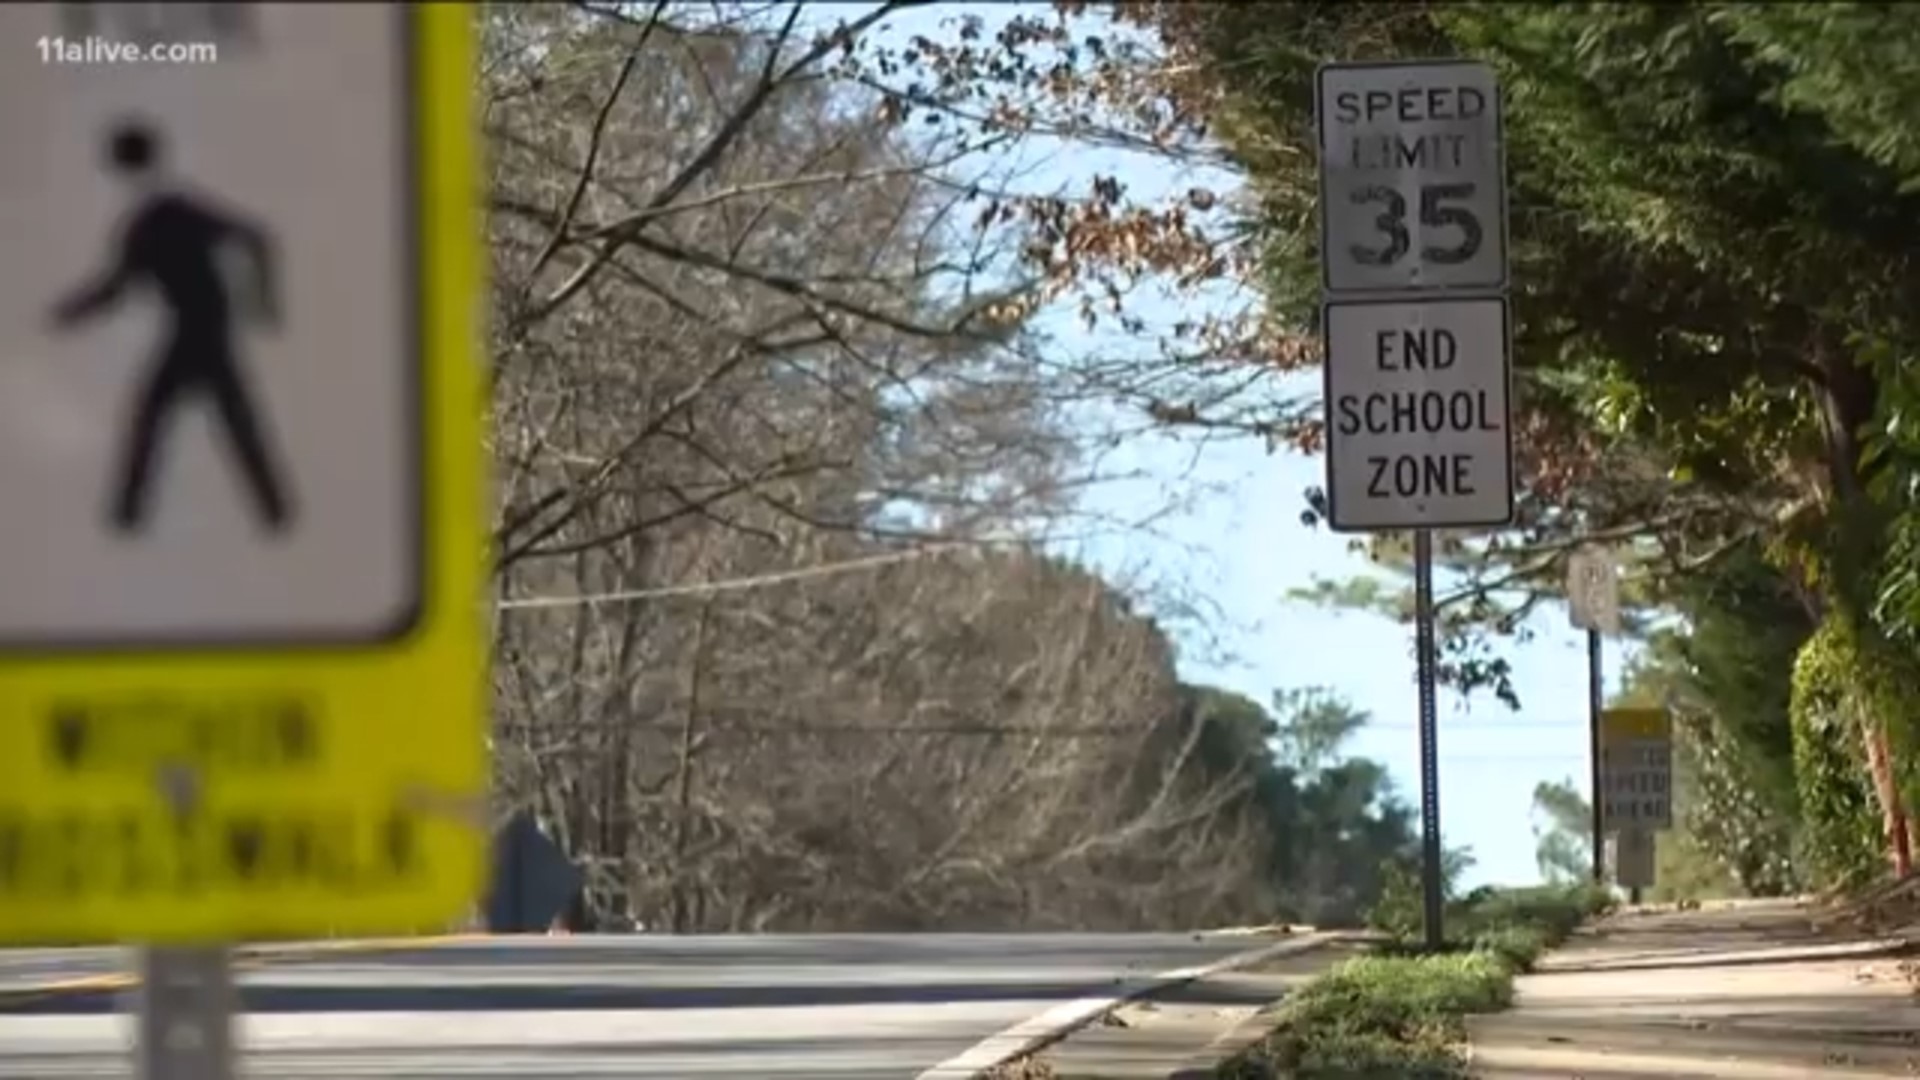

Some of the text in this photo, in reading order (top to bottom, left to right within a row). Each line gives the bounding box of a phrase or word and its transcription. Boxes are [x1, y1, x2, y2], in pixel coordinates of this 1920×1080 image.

[1335, 86, 1486, 124] SPEED
[1351, 135, 1465, 169] LIMIT
[1347, 182, 1483, 266] 35
[1377, 329, 1457, 371] END
[1338, 389, 1500, 435] SCHOOL
[1367, 454, 1476, 498] ZONE
